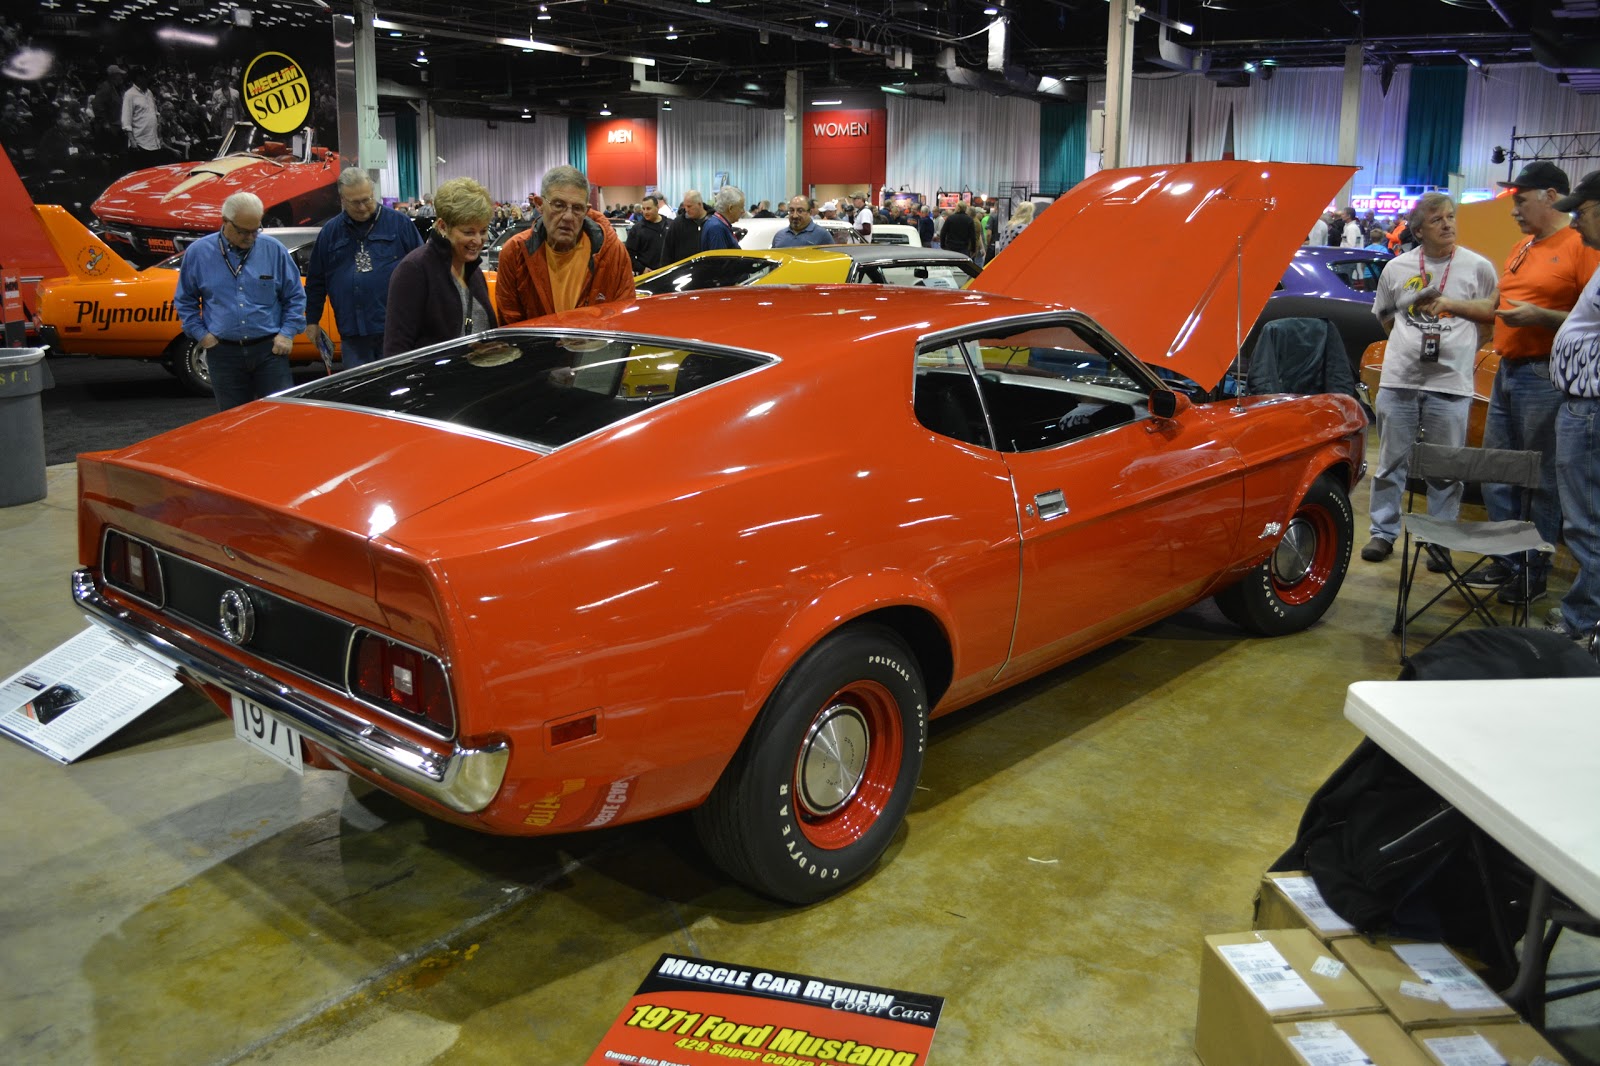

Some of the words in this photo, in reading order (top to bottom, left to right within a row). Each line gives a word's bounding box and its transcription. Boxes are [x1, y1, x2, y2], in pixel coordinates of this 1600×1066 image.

[247, 65, 299, 97] MECUM
[253, 82, 307, 120] SOLD
[608, 129, 633, 143] MEN
[813, 121, 868, 137] WOMEN
[1352, 199, 1417, 209] CHEVROLE
[73, 301, 180, 331] Plymouth
[868, 655, 910, 681] POLYGLAS
[240, 698, 295, 757] 1971
[779, 783, 840, 879] GOODYEAR
[658, 957, 752, 987] MUSCLE
[751, 972, 802, 995] CAR
[802, 980, 895, 1008] REVIEW
[831, 999, 886, 1014] Cover
[888, 1005, 931, 1020] Cars
[625, 1004, 702, 1034] 1971
[692, 1014, 776, 1048] Ford
[766, 1027, 917, 1066] Mustang
[604, 1049, 639, 1063] Owner:
[674, 1037, 711, 1052] 429
[708, 1043, 763, 1062] Super
